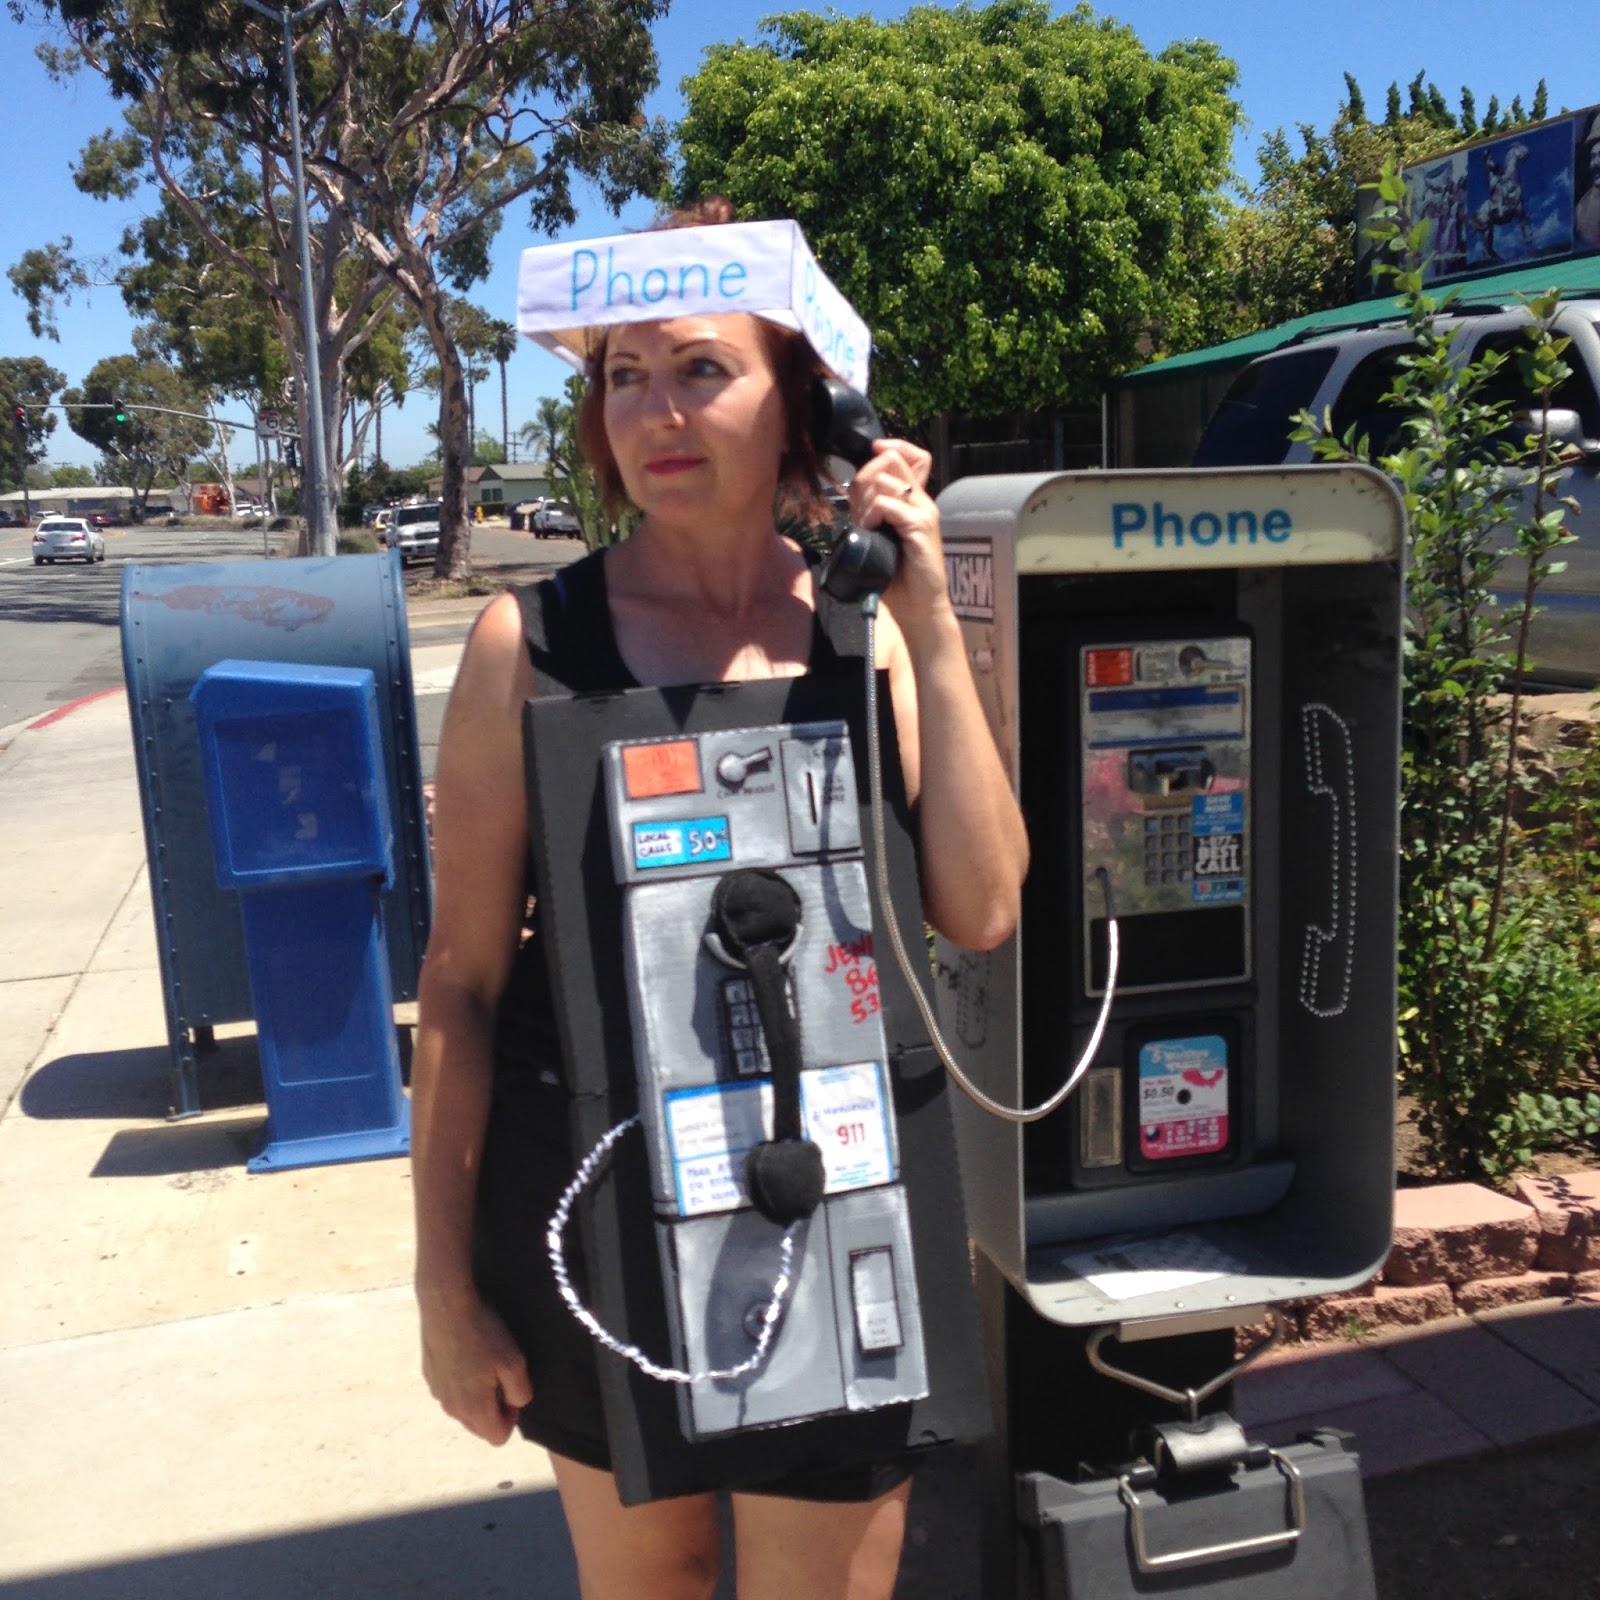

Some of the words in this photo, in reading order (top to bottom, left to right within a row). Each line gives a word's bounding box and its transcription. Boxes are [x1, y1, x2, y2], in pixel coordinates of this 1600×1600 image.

[569, 247, 748, 311] Phone
[1111, 502, 1293, 549] Phone
[850, 992, 881, 1024] 53
[836, 1122, 865, 1146] 911
